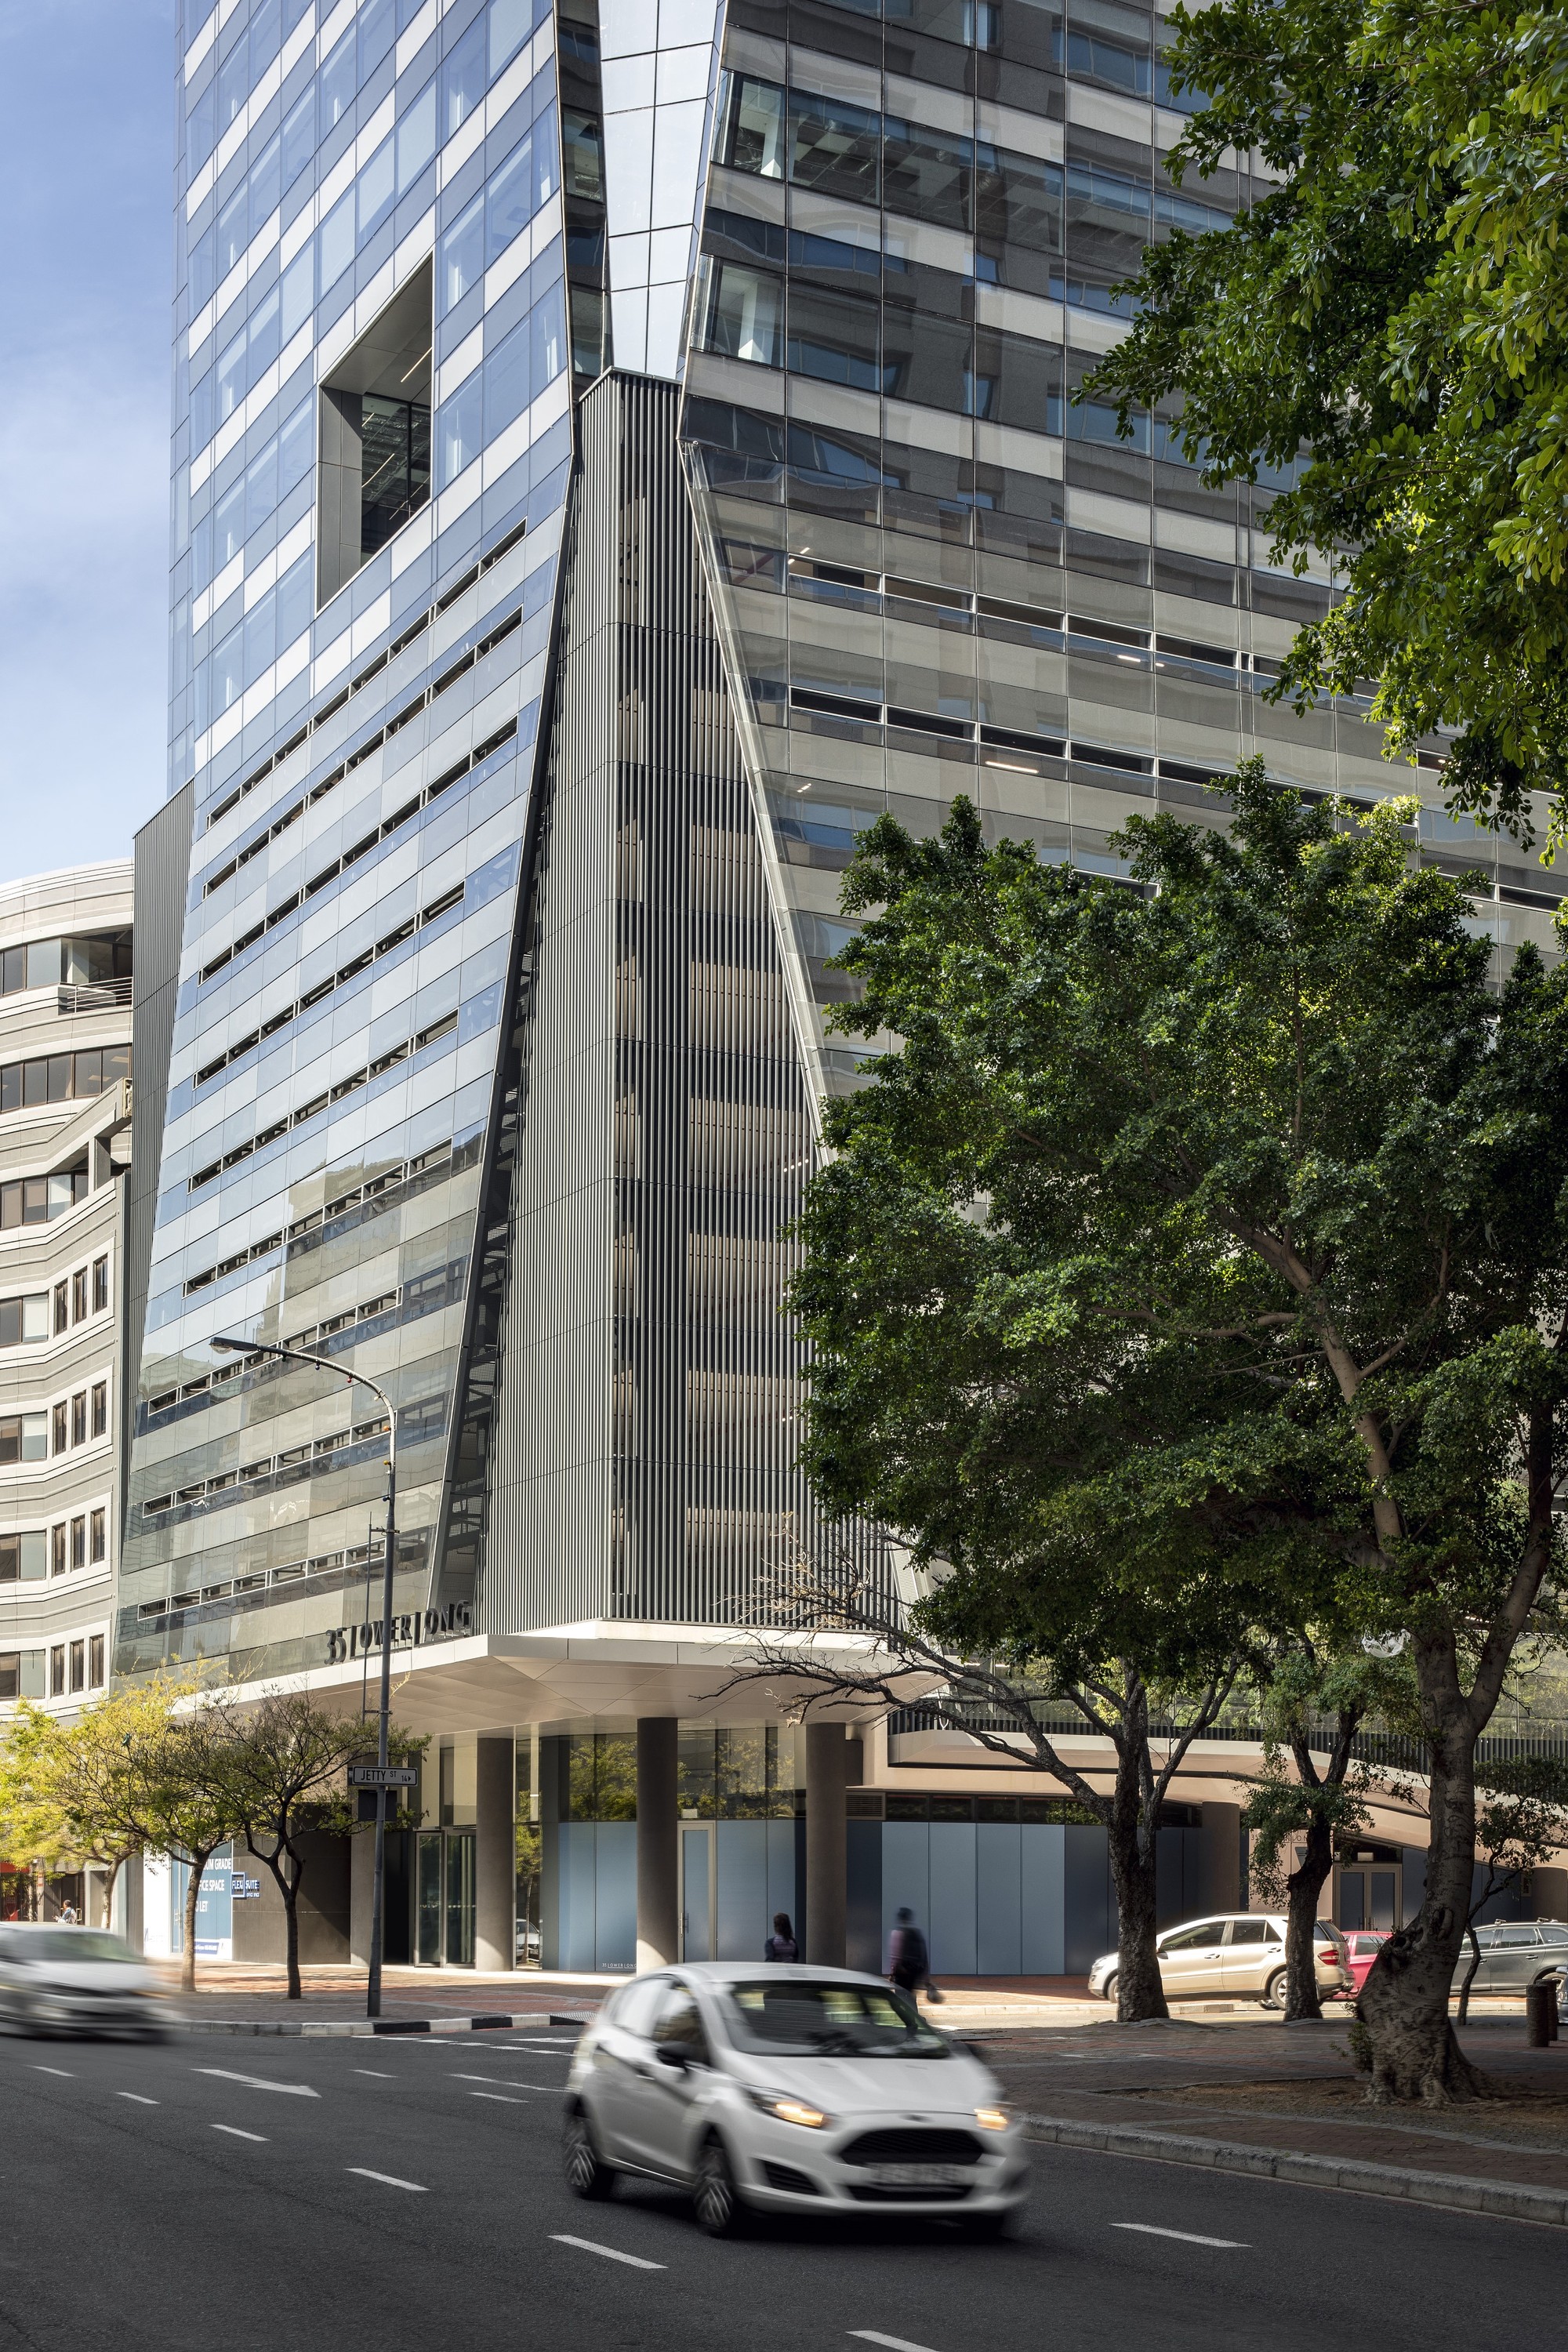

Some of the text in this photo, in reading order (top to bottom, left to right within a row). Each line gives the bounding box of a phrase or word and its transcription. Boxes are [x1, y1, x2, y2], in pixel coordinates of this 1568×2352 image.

[324, 1628, 347, 1665] 35
[414, 1599, 470, 1648] LONG
[361, 1769, 387, 1781] JETTY
[215, 1858, 231, 1870] GRADE
[209, 1879, 225, 1891] SPACE
[199, 1900, 208, 1912] LET
